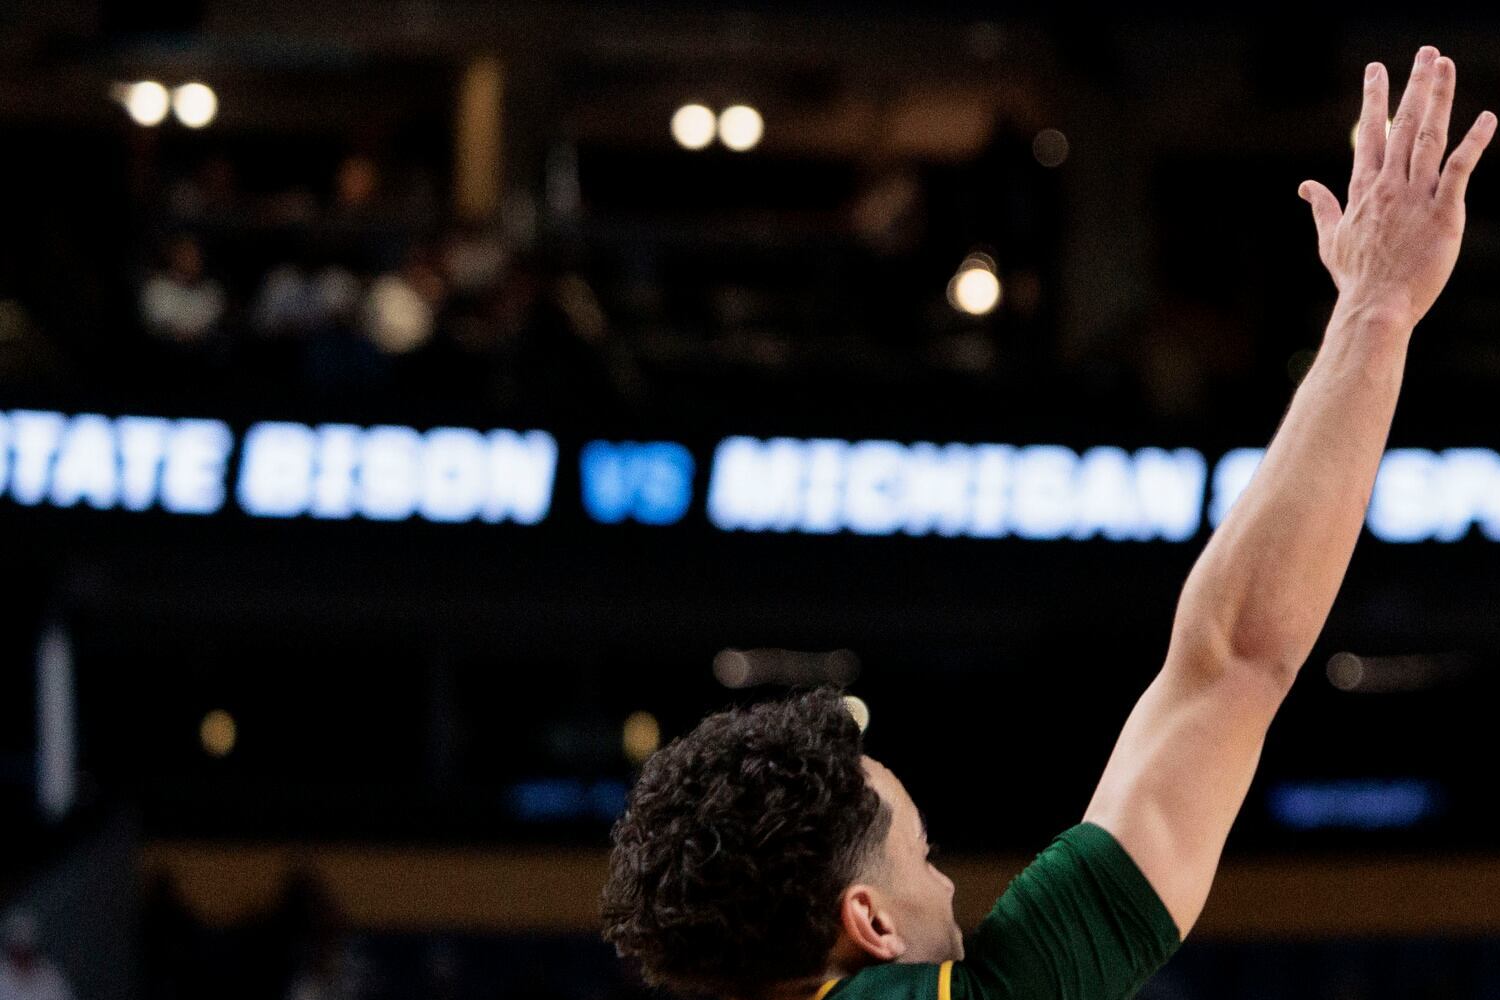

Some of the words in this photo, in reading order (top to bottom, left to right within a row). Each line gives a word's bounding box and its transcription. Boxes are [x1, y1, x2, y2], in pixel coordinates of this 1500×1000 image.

[0, 408, 234, 514] TATE
[237, 420, 559, 526] BISON
[706, 436, 1208, 543] MICHIGAN
